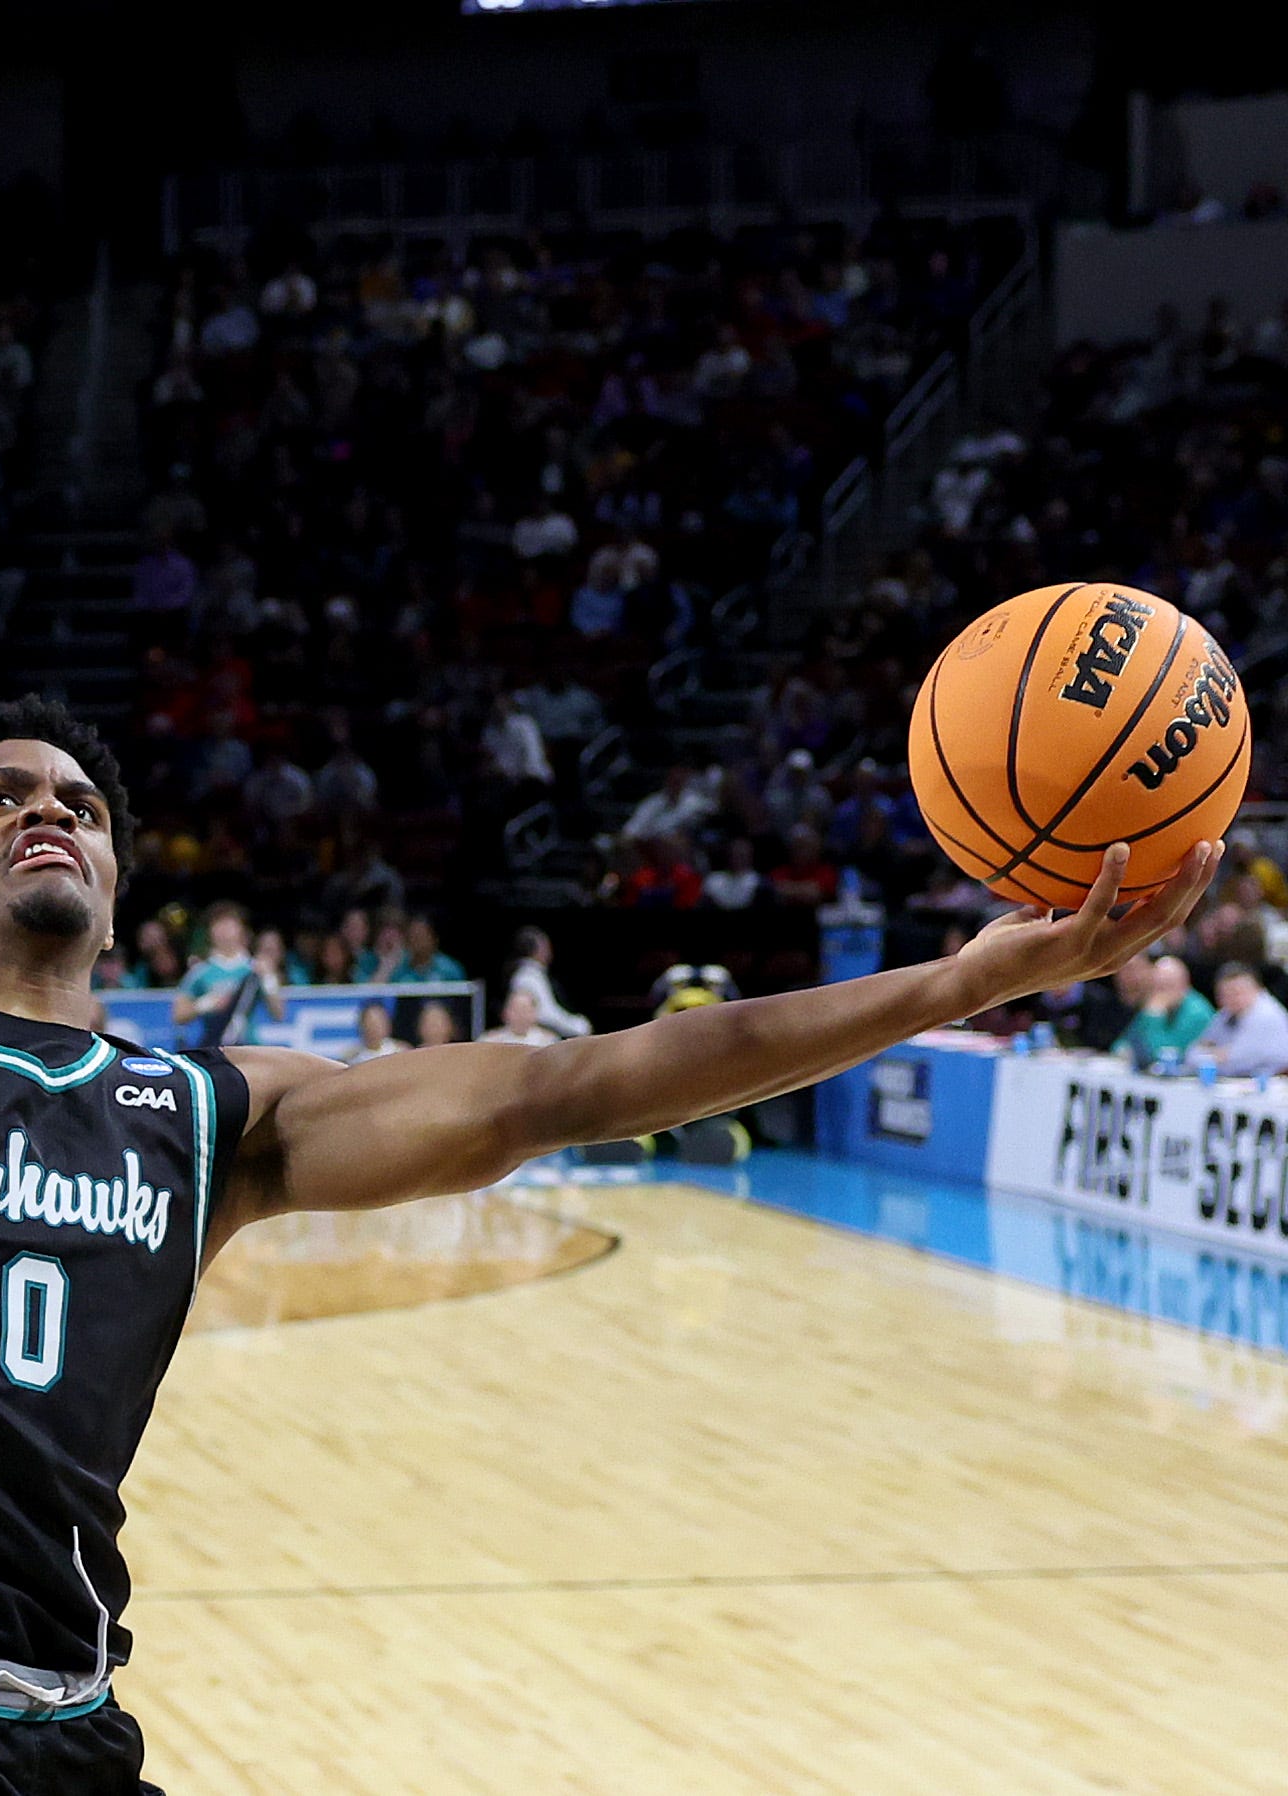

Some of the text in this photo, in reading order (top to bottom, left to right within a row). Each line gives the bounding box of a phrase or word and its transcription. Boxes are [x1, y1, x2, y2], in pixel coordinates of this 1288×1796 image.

[1058, 592, 1156, 710] NCAA
[115, 1084, 178, 1112] CAA
[1054, 1081, 1159, 1204] FIRST
